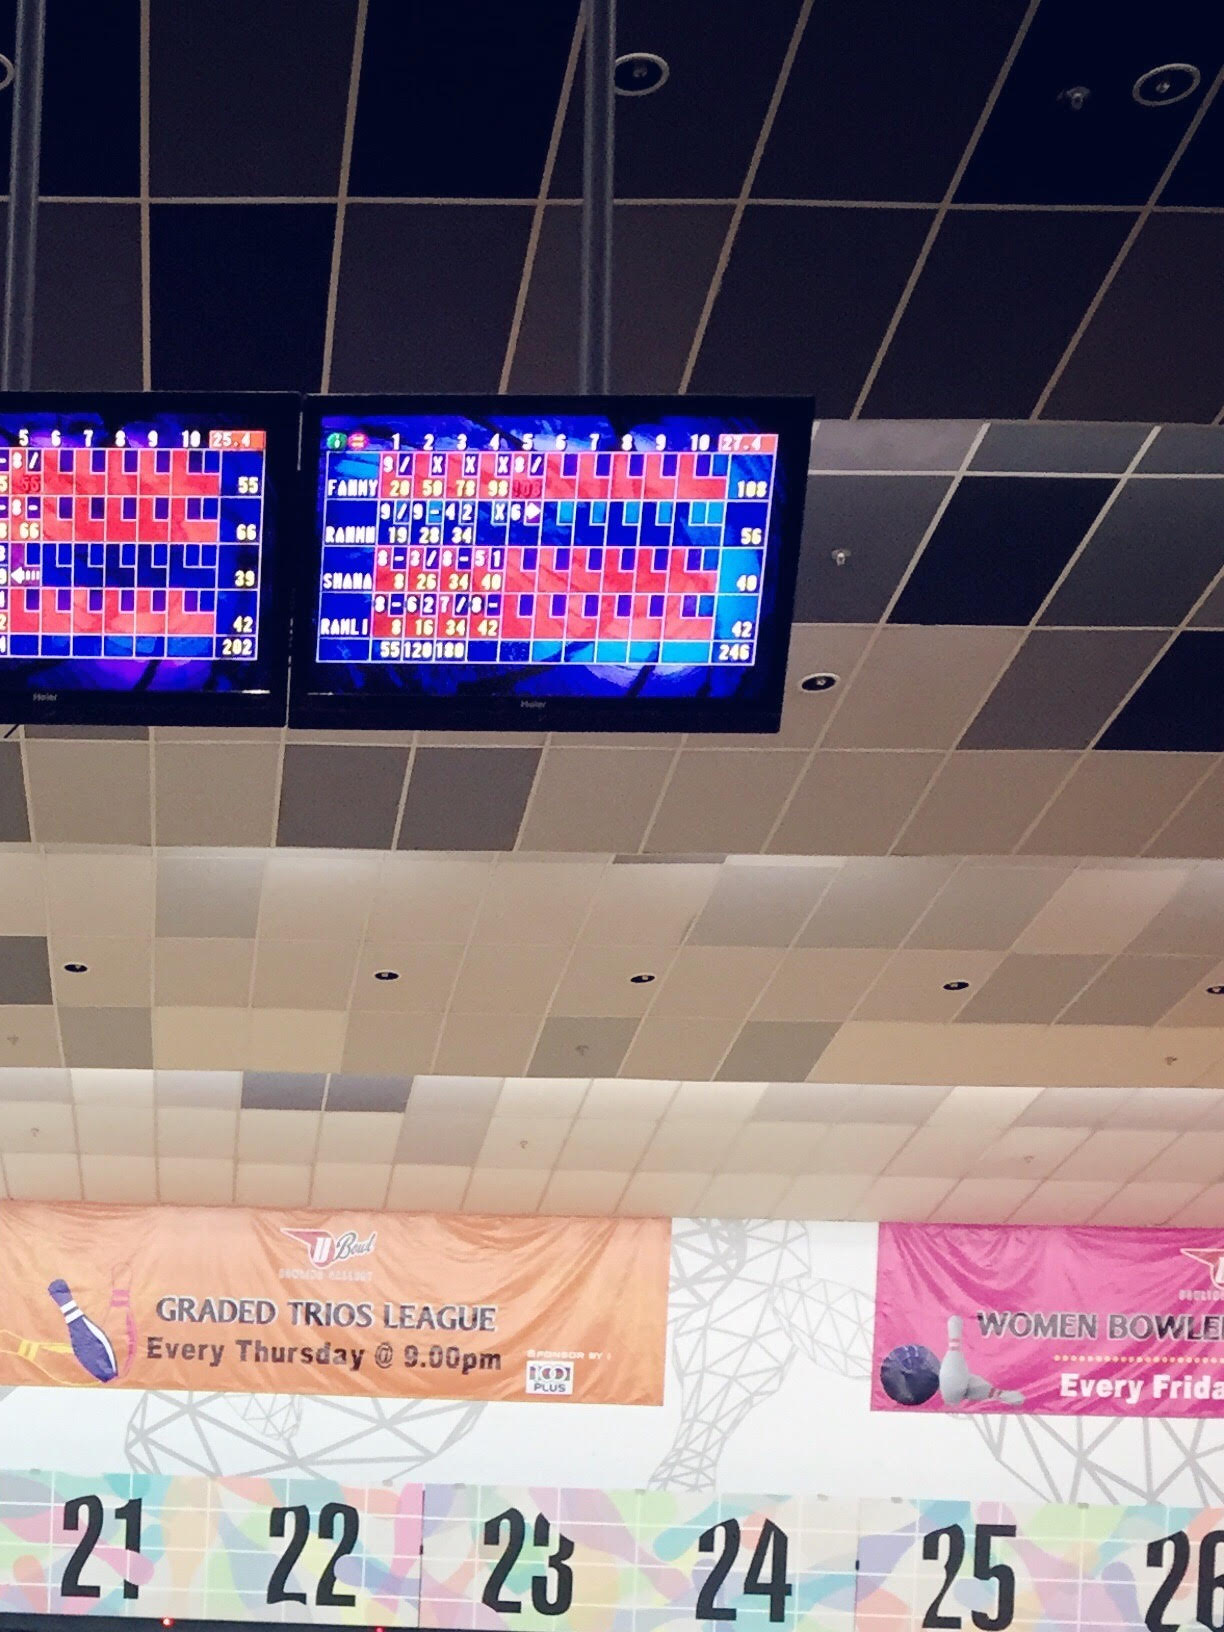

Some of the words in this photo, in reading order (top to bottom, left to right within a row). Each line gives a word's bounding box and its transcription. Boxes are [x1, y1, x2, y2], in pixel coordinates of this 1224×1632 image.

[19, 429, 29, 446] 5
[51, 430, 61, 447] 6
[84, 430, 94, 447] 7
[115, 430, 126, 447] 8
[147, 430, 159, 447] 9
[182, 430, 201, 448] 10
[213, 433, 251, 447] 25.4
[392, 433, 400, 450] 1
[423, 434, 434, 450] 2
[457, 434, 467, 450] 3
[489, 434, 500, 451] 4
[523, 434, 533, 451] 5
[556, 434, 566, 450] 6
[590, 434, 599, 451] 7
[622, 434, 633, 451] 8
[656, 434, 666, 451] 9
[691, 434, 710, 451] 10
[238, 477, 258, 494] 55
[456, 480, 475, 497] 78
[488, 480, 508, 497] 98
[737, 481, 767, 498] 108
[20, 522, 40, 539] 66
[236, 524, 257, 541] 66
[388, 527, 408, 543] 19
[420, 527, 440, 543] 28
[452, 527, 472, 543] 34
[741, 528, 761, 545] 56
[235, 570, 255, 587] 39
[417, 573, 436, 590] 26
[449, 573, 468, 590] 34
[233, 616, 253, 633] 42
[445, 620, 466, 636] 34
[477, 620, 498, 636] 42
[732, 621, 752, 638] 42
[222, 639, 252, 656] 202
[380, 641, 401, 658] 55
[403, 641, 432, 658] 120
[436, 641, 465, 658] 180
[719, 644, 750, 661] 246
[155, 1296, 276, 1326] GRADED
[287, 1299, 373, 1329] TRIOS
[382, 1303, 498, 1333] LEAGUE
[976, 1310, 1097, 1340] WOMEN
[1107, 1313, 1224, 1343] BOWLE
[145, 1336, 227, 1370] Every
[235, 1339, 365, 1371] Thursday
[374, 1344, 394, 1371] @
[403, 1345, 502, 1373] 9.00pm
[534, 1382, 566, 1393] PLUS
[1060, 1373, 1144, 1405] Every
[62, 1495, 142, 1600] 21
[268, 1502, 360, 1607] 22
[482, 1507, 574, 1615] 23
[696, 1518, 792, 1623] 24
[922, 1524, 1016, 1631] 25
